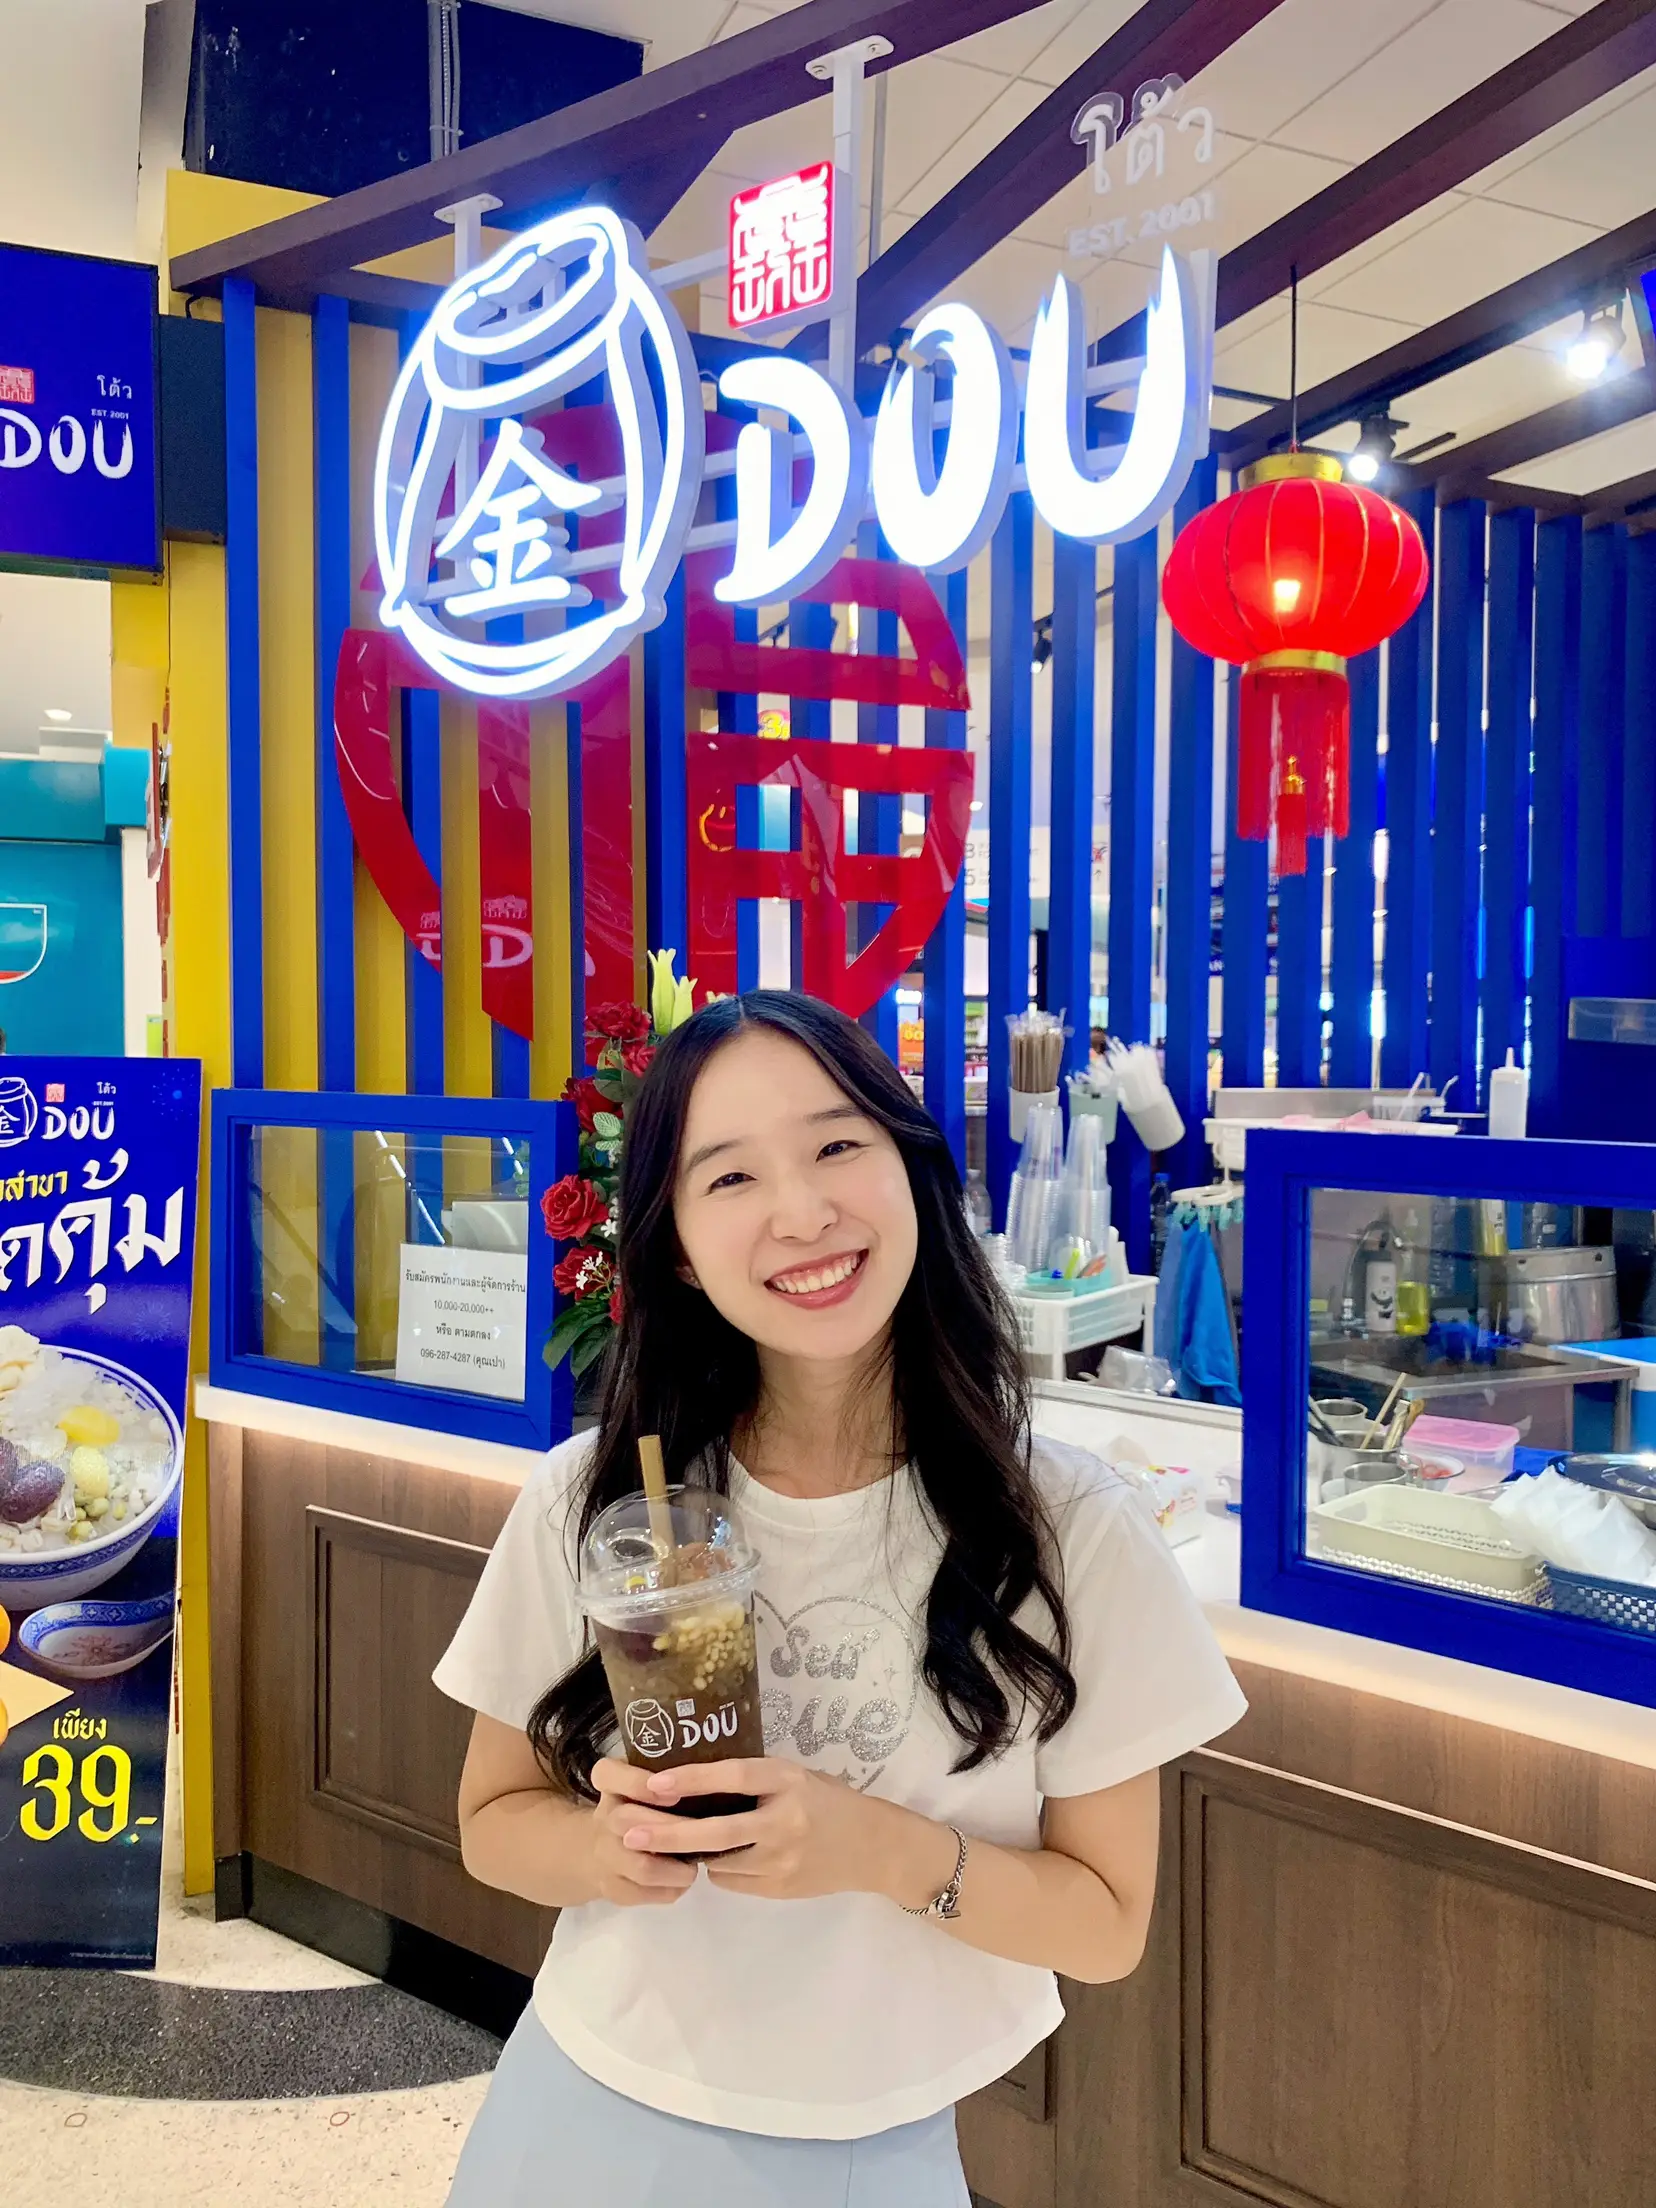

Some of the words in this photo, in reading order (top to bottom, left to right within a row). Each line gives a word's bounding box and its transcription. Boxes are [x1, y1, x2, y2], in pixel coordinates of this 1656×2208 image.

[0, 408, 133, 479] DOU
[714, 243, 1188, 606] DOU
[435, 419, 603, 617] 金
[41, 1106, 115, 1140] DOU
[0, 1169, 68, 1202] สาขา
[53, 1708, 107, 1740] เพียง
[636, 1722, 661, 1747] 金
[678, 1706, 738, 1748] DOU
